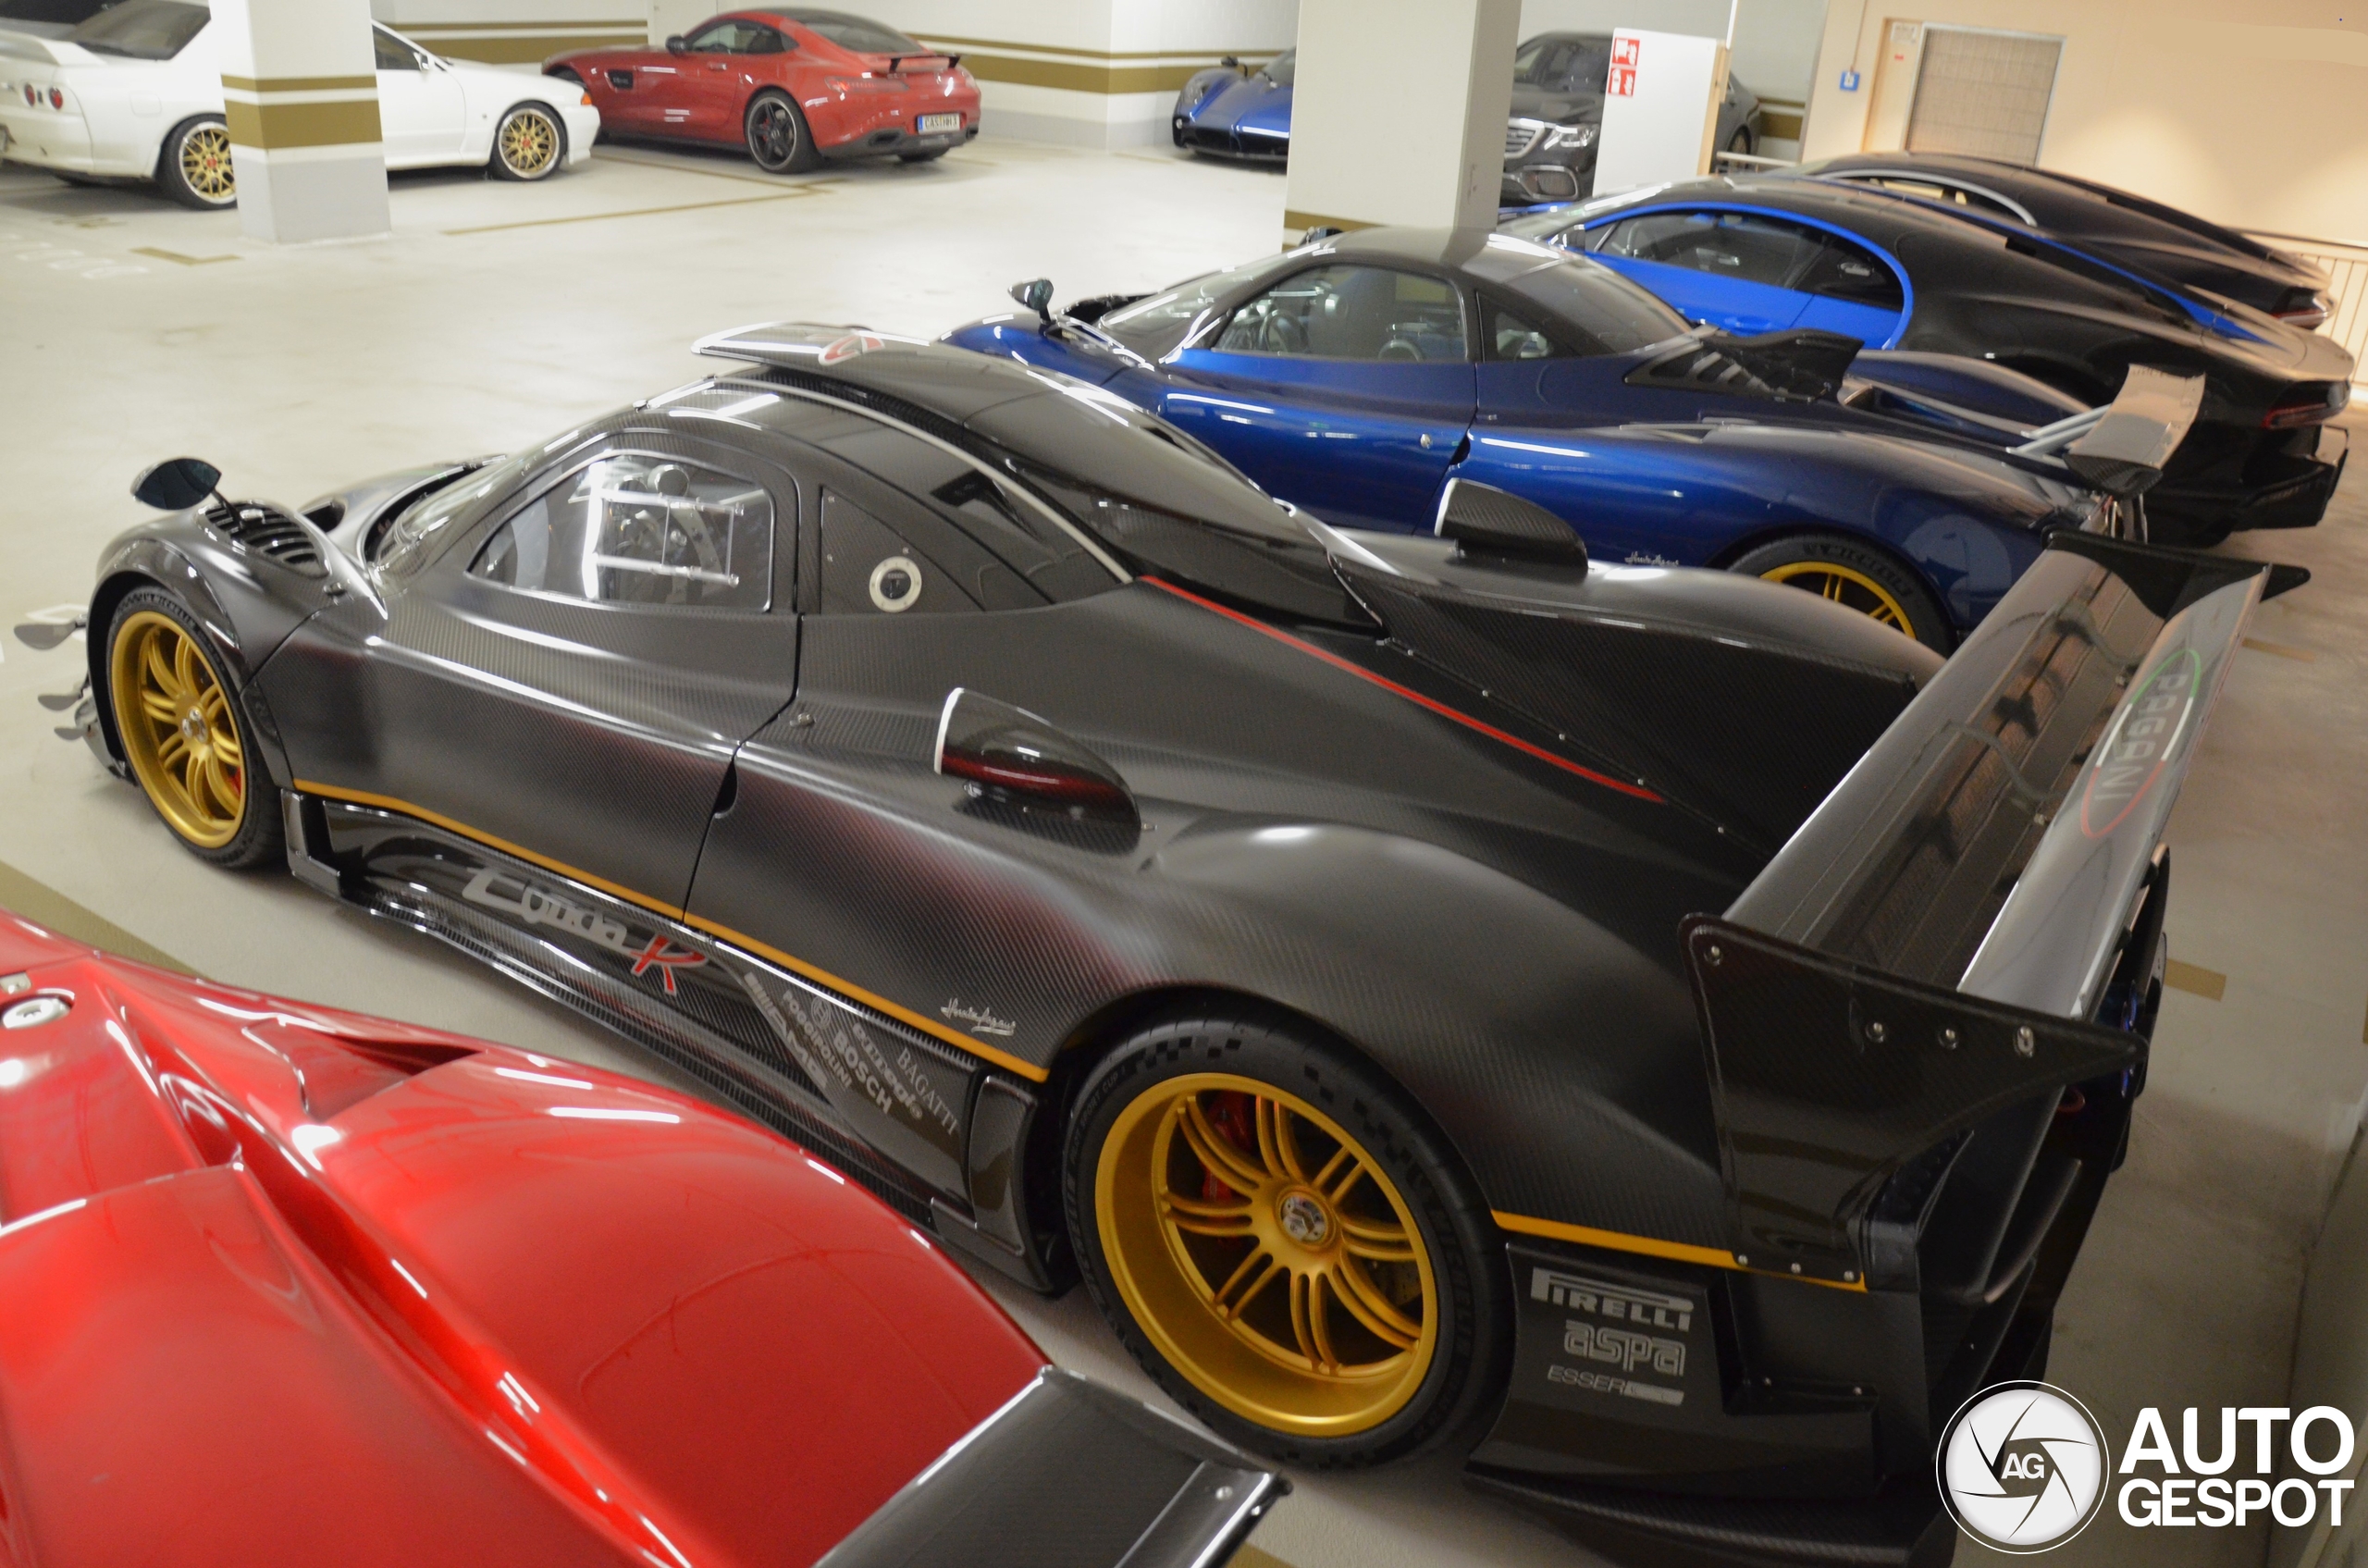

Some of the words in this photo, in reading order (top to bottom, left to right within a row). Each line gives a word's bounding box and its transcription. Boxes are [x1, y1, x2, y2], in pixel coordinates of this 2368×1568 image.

[2093, 673, 2189, 802] PAGANI
[630, 933, 709, 996] R
[783, 990, 852, 1089] POGGIPOLINI
[832, 1031, 892, 1115] BOSCH
[897, 1047, 959, 1135] BAGATTI
[1098, 1070, 1121, 1094] CUP
[1531, 1266, 1695, 1332] PIRELLI
[1548, 1364, 1626, 1396] ESSER
[1564, 1319, 1686, 1377] aspa
